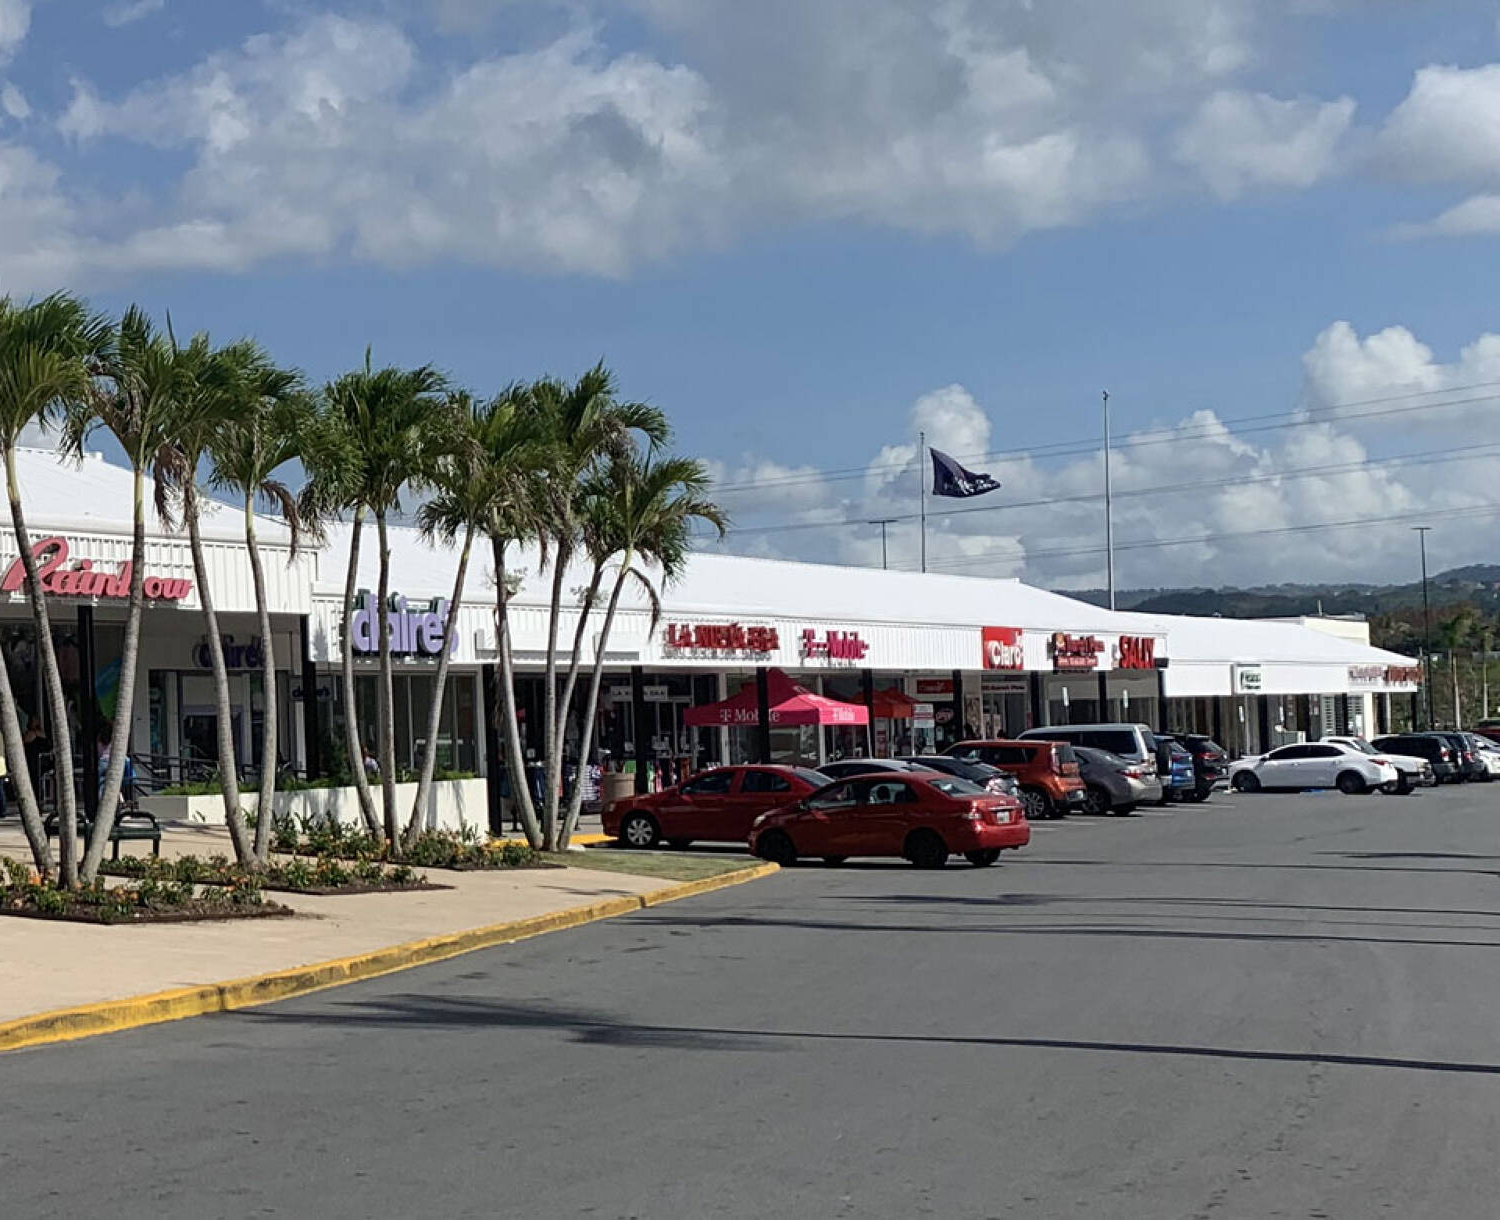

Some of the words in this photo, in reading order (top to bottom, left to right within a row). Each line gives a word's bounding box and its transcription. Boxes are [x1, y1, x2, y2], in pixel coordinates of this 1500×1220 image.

[988, 640, 1023, 665] Claro
[1119, 636, 1156, 668] SALLY
[734, 708, 780, 722] Mole
